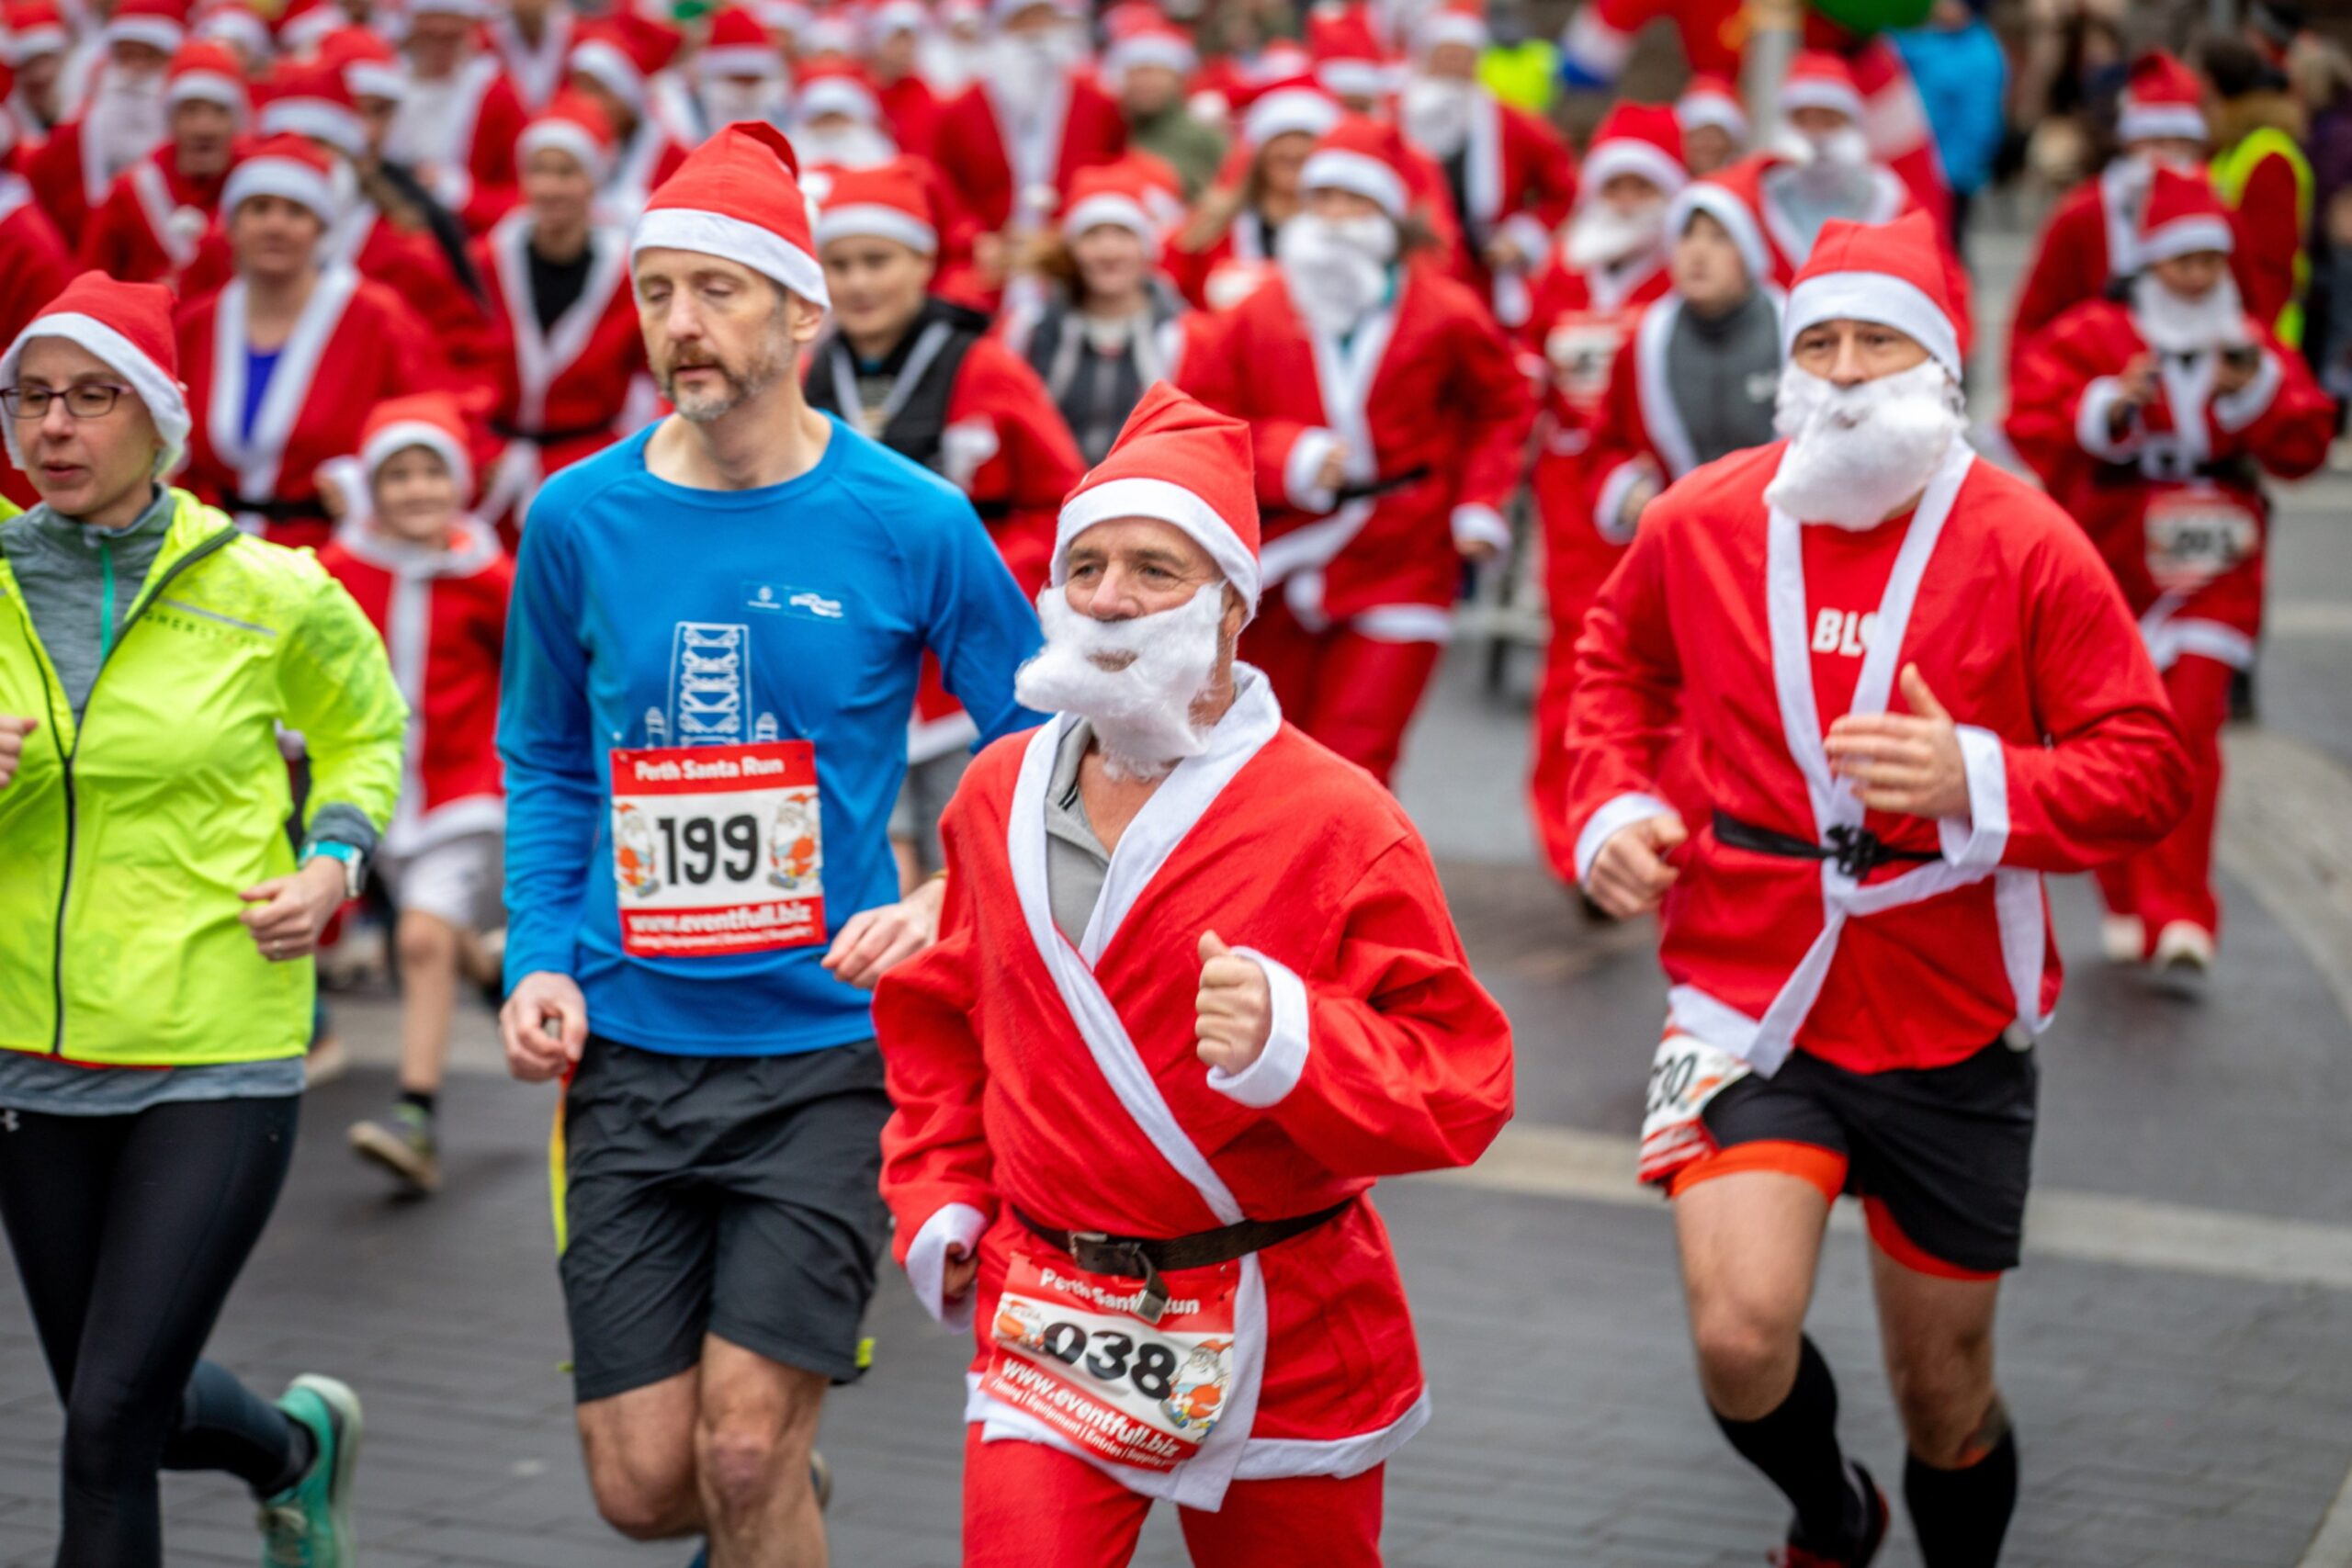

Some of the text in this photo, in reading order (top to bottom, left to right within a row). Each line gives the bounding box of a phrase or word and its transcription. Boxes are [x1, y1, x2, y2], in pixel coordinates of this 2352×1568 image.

[634, 755, 785, 781] Perth Santa Run
[657, 815, 760, 886] 199
[1039, 1268, 1091, 1299] Perth
[1091, 1287, 1140, 1312] Sant
[1043, 1322, 1177, 1401] 038
[1001, 1358, 1181, 1458] www.eventfull.biz
